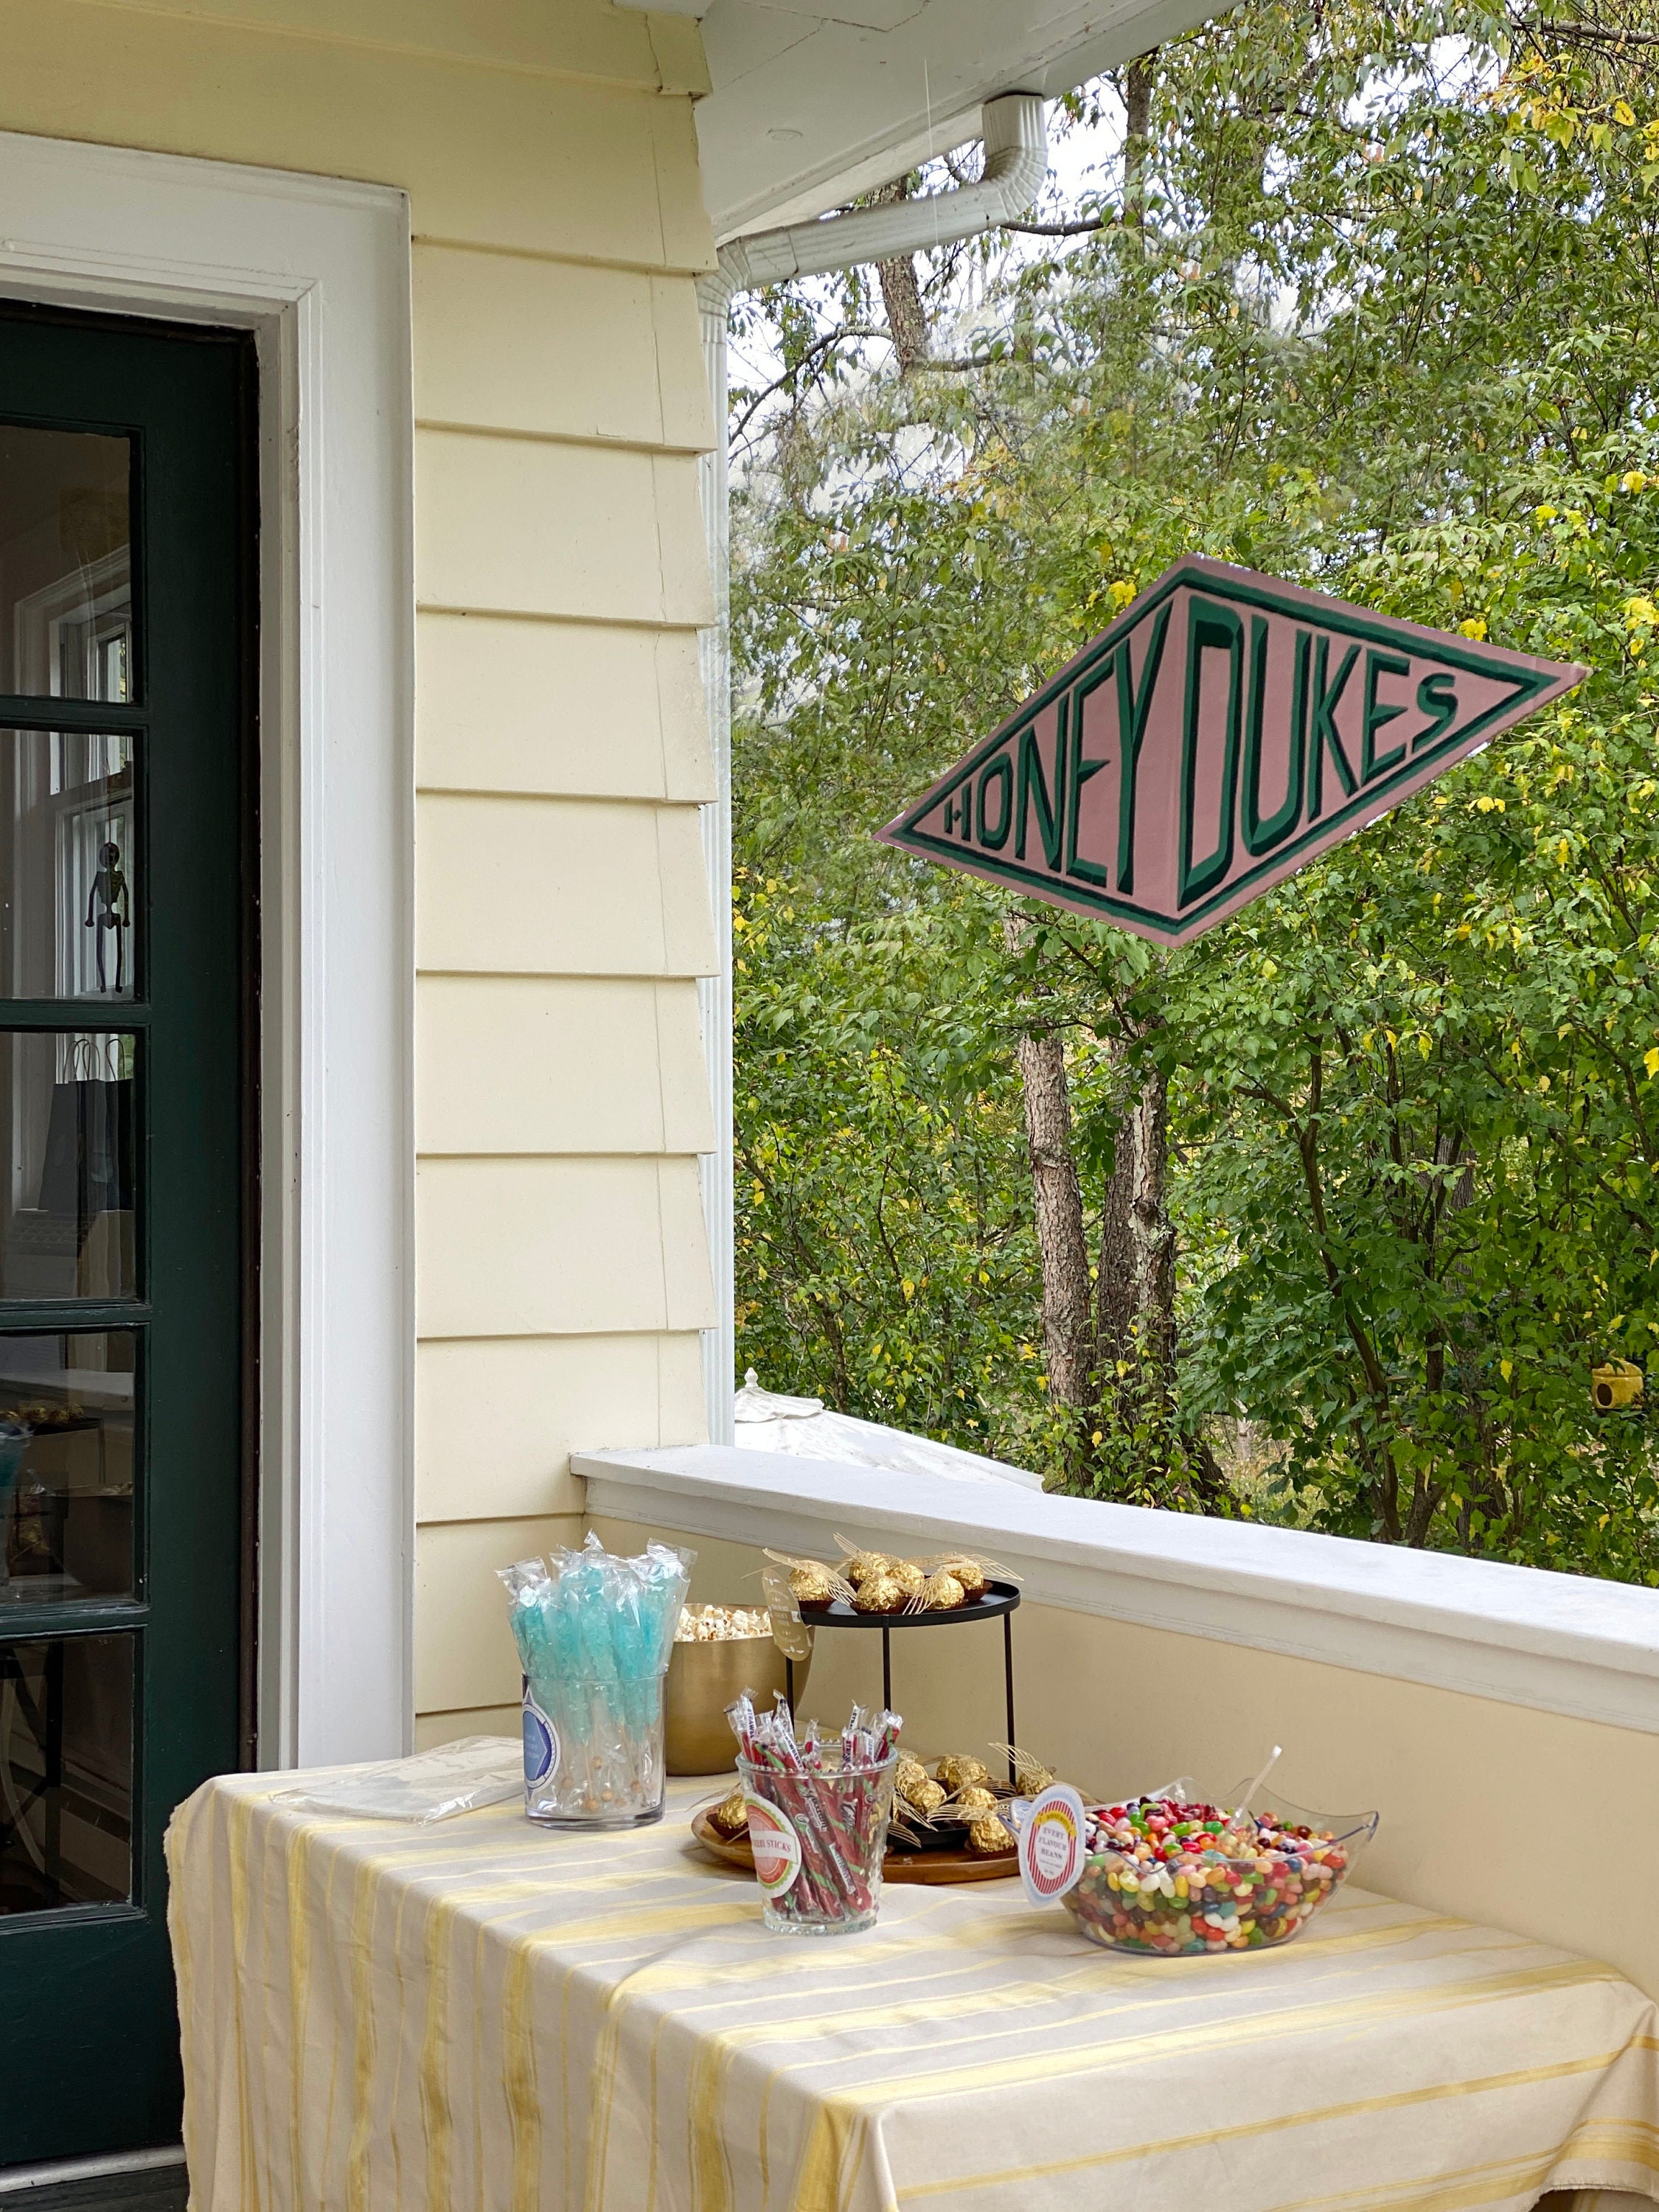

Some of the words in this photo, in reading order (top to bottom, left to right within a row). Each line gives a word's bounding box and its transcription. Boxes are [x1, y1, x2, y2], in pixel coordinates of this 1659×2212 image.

[1043, 1827, 1065, 1839] EVERY
[766, 1840, 791, 1852] STICKS
[1038, 1837, 1067, 1851] FLAVOUR
[1041, 1848, 1062, 1860] BEANS
